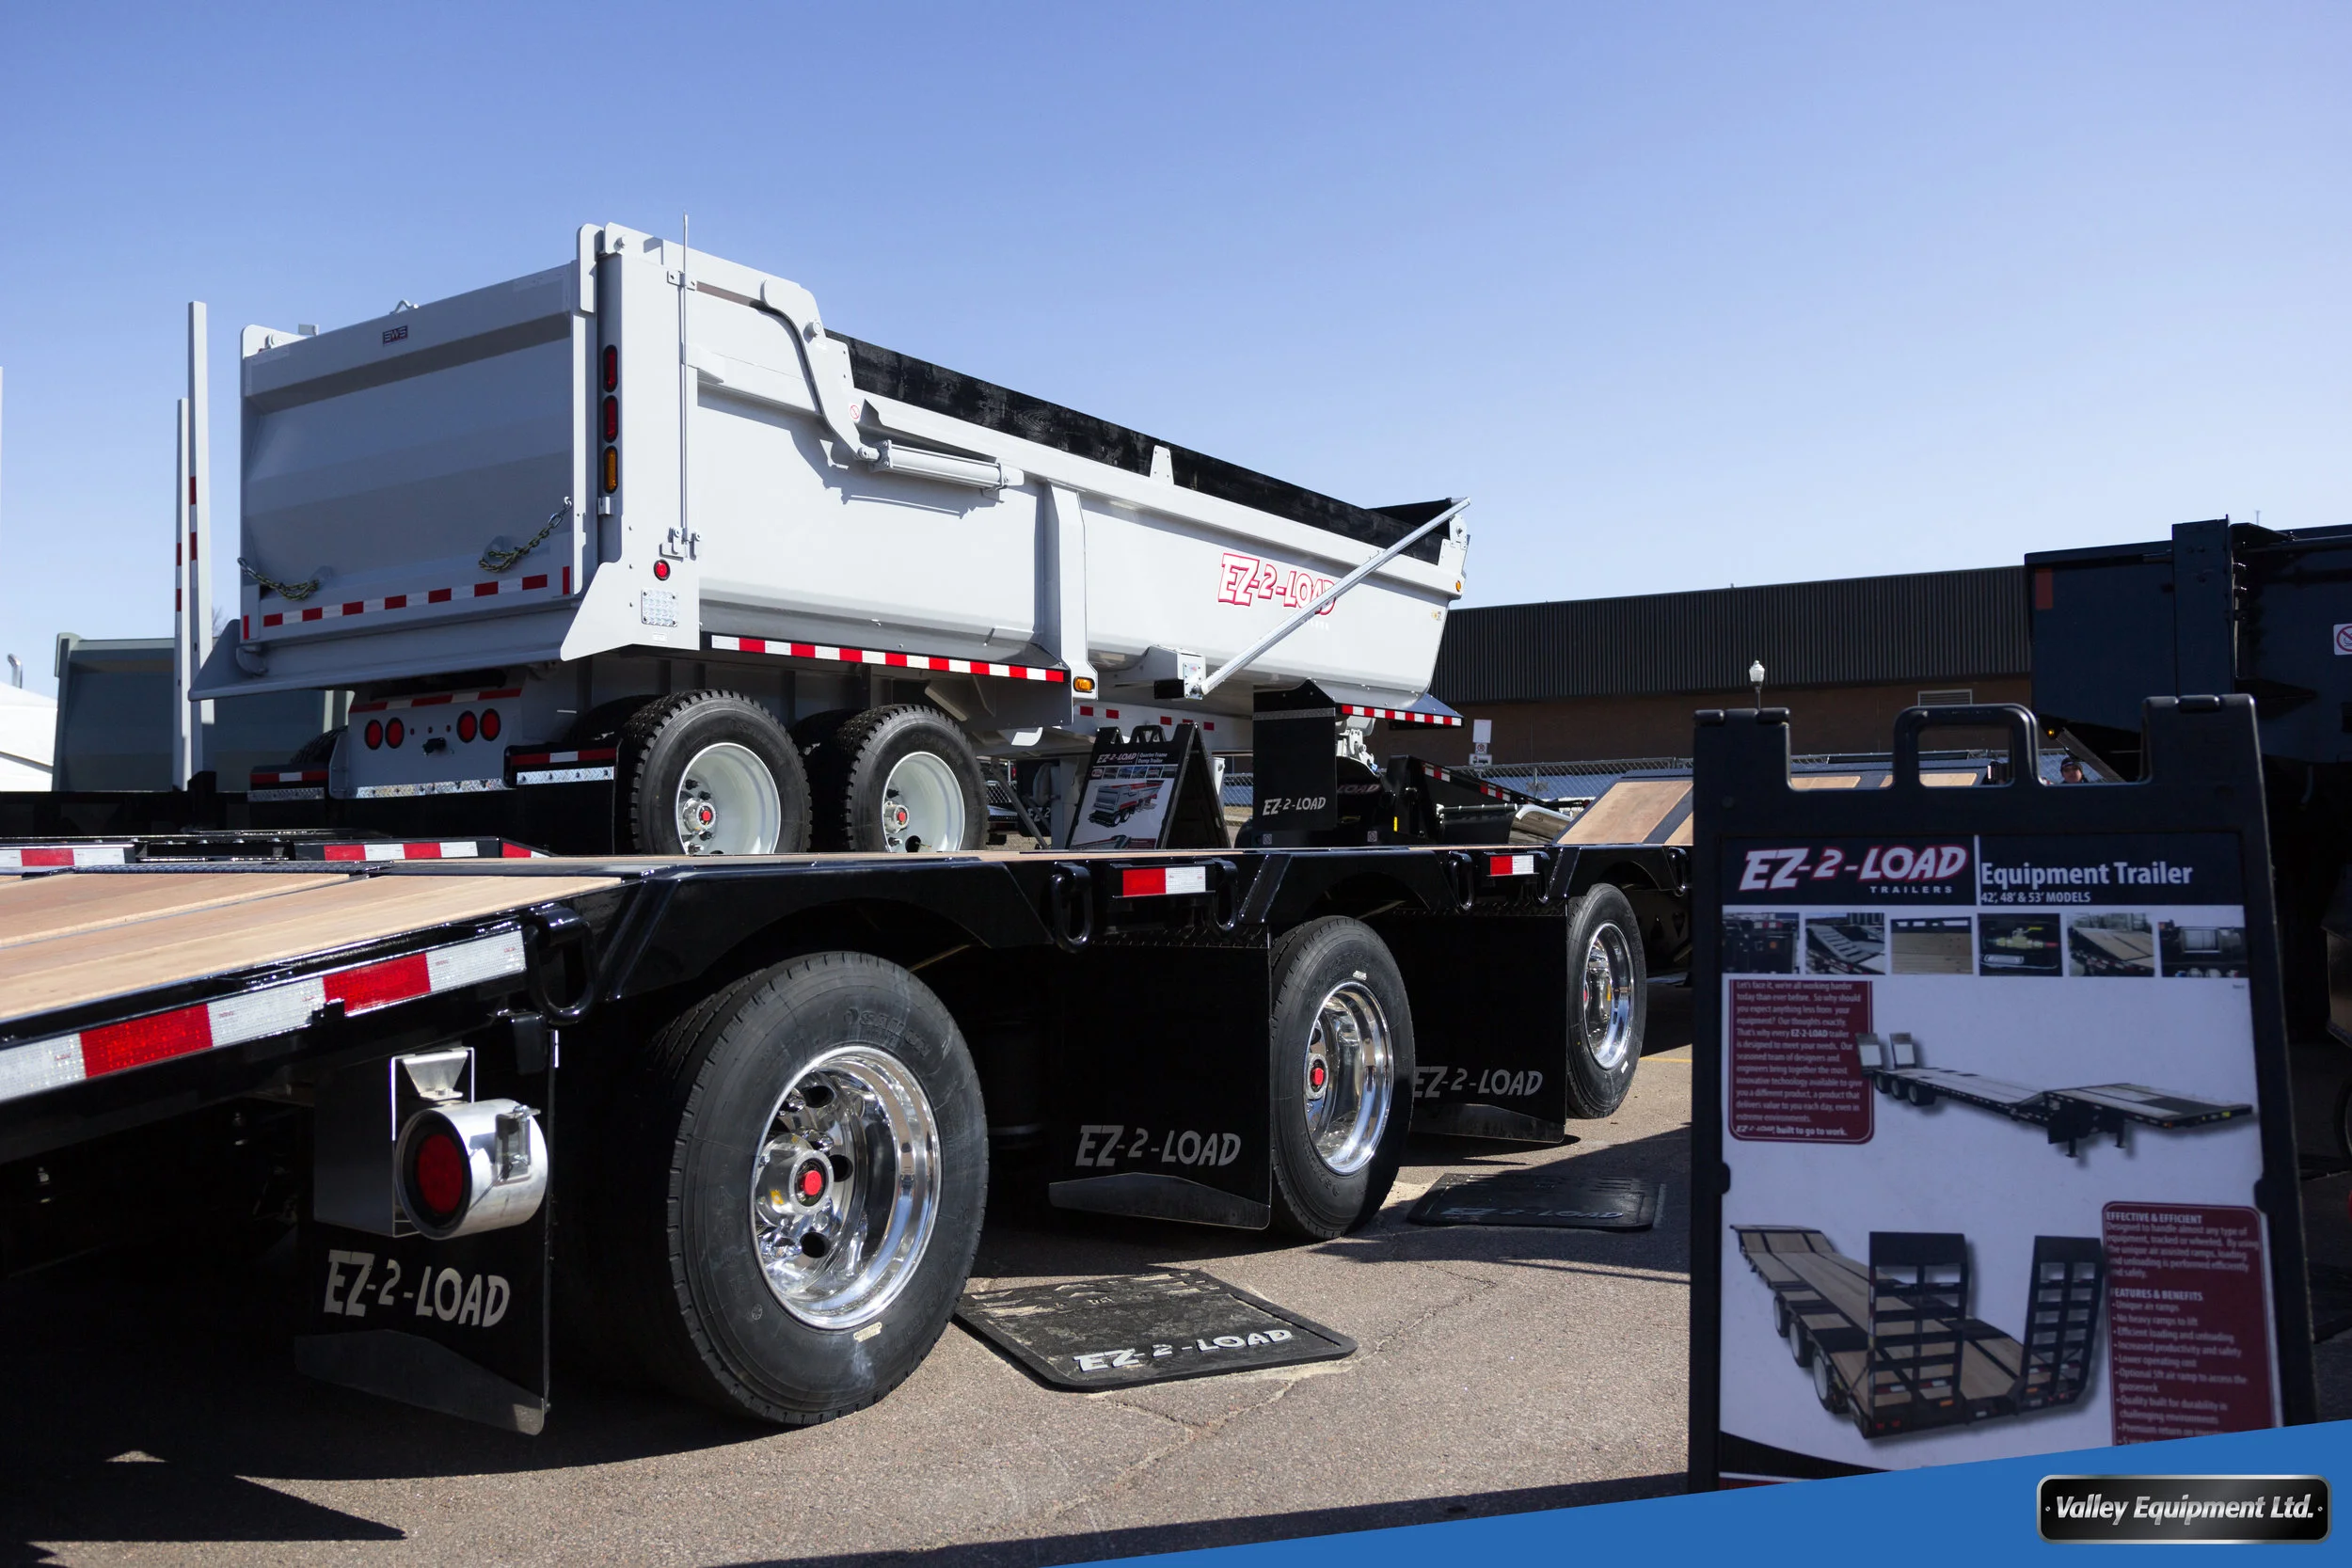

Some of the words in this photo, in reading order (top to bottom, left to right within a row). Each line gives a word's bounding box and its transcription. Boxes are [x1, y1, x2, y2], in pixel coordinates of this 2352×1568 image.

[1097, 752, 1136, 763] EZ-2-LOAD
[1262, 797, 1327, 816] EZ-2-LOAD
[1739, 845, 1968, 891] EZ-2-LOAD
[1981, 863, 2110, 890] Equipment
[2113, 862, 2192, 884] Trailer
[1870, 885, 1953, 894] TRAILERS
[2018, 893, 2026, 903] &
[2046, 892, 2090, 903] MODELS
[1753, 981, 1765, 990] face
[1803, 982, 1829, 991] working
[1737, 993, 1755, 1002] today
[1824, 994, 1837, 1003] why
[1772, 1006, 1801, 1014] anything
[1791, 1018, 1820, 1026] thoughts
[1737, 1028, 1755, 1037] That's
[1757, 1029, 1770, 1037] why
[1743, 1040, 1772, 1050] designed
[1795, 1053, 1825, 1063] designers
[1770, 1066, 1787, 1074] bring
[1788, 1067, 1817, 1075] together
[1414, 1066, 1543, 1098] EZ-2-LOAD
[1772, 1078, 1807, 1087] technology
[1776, 1126, 1794, 1134] built
[1804, 1128, 1815, 1136] go
[1826, 1127, 1848, 1135] work.
[1074, 1124, 1242, 1167] EZ-2-LOAD
[2106, 1212, 2149, 1222] EFFECTIVE
[2151, 1214, 2158, 1223] &
[2160, 1214, 2201, 1224] EFFICIENT
[2106, 1222, 2140, 1232] Designed
[2152, 1224, 2177, 1232] handle
[2179, 1226, 2204, 1234] almost
[2206, 1227, 2219, 1236] any
[2221, 1227, 2237, 1237] type
[2239, 1227, 2248, 1236] of
[2151, 1236, 2178, 1244] tracked
[2227, 1239, 2236, 1247] By
[2238, 1241, 2259, 1250] using
[2123, 1258, 2161, 1268] unloading
[2170, 1259, 2210, 1270] performed
[2212, 1262, 2249, 1273] efficiently
[323, 1248, 511, 1328] EZ-2-LOAD
[2153, 1290, 2160, 1299] &
[2162, 1291, 2203, 1301] BENEFITS
[2129, 1314, 2151, 1324] heavy
[2153, 1316, 2176, 1326] ramps
[2178, 1317, 2185, 1325] to
[2187, 1317, 2198, 1325] lift
[2117, 1326, 2148, 1336] Efficient
[2150, 1328, 2178, 1340] loading
[2179, 1330, 2193, 1339] and
[2195, 1331, 2234, 1343] unloading
[1073, 1329, 1295, 1373] EZ-2-LOAD
[2118, 1341, 2153, 1351] Increased
[2155, 1342, 2201, 1354] productivity
[2218, 1346, 2241, 1357] safety
[2120, 1355, 2141, 1364] Lower
[2142, 1356, 2180, 1367] operating
[2182, 1358, 2197, 1367] cost
